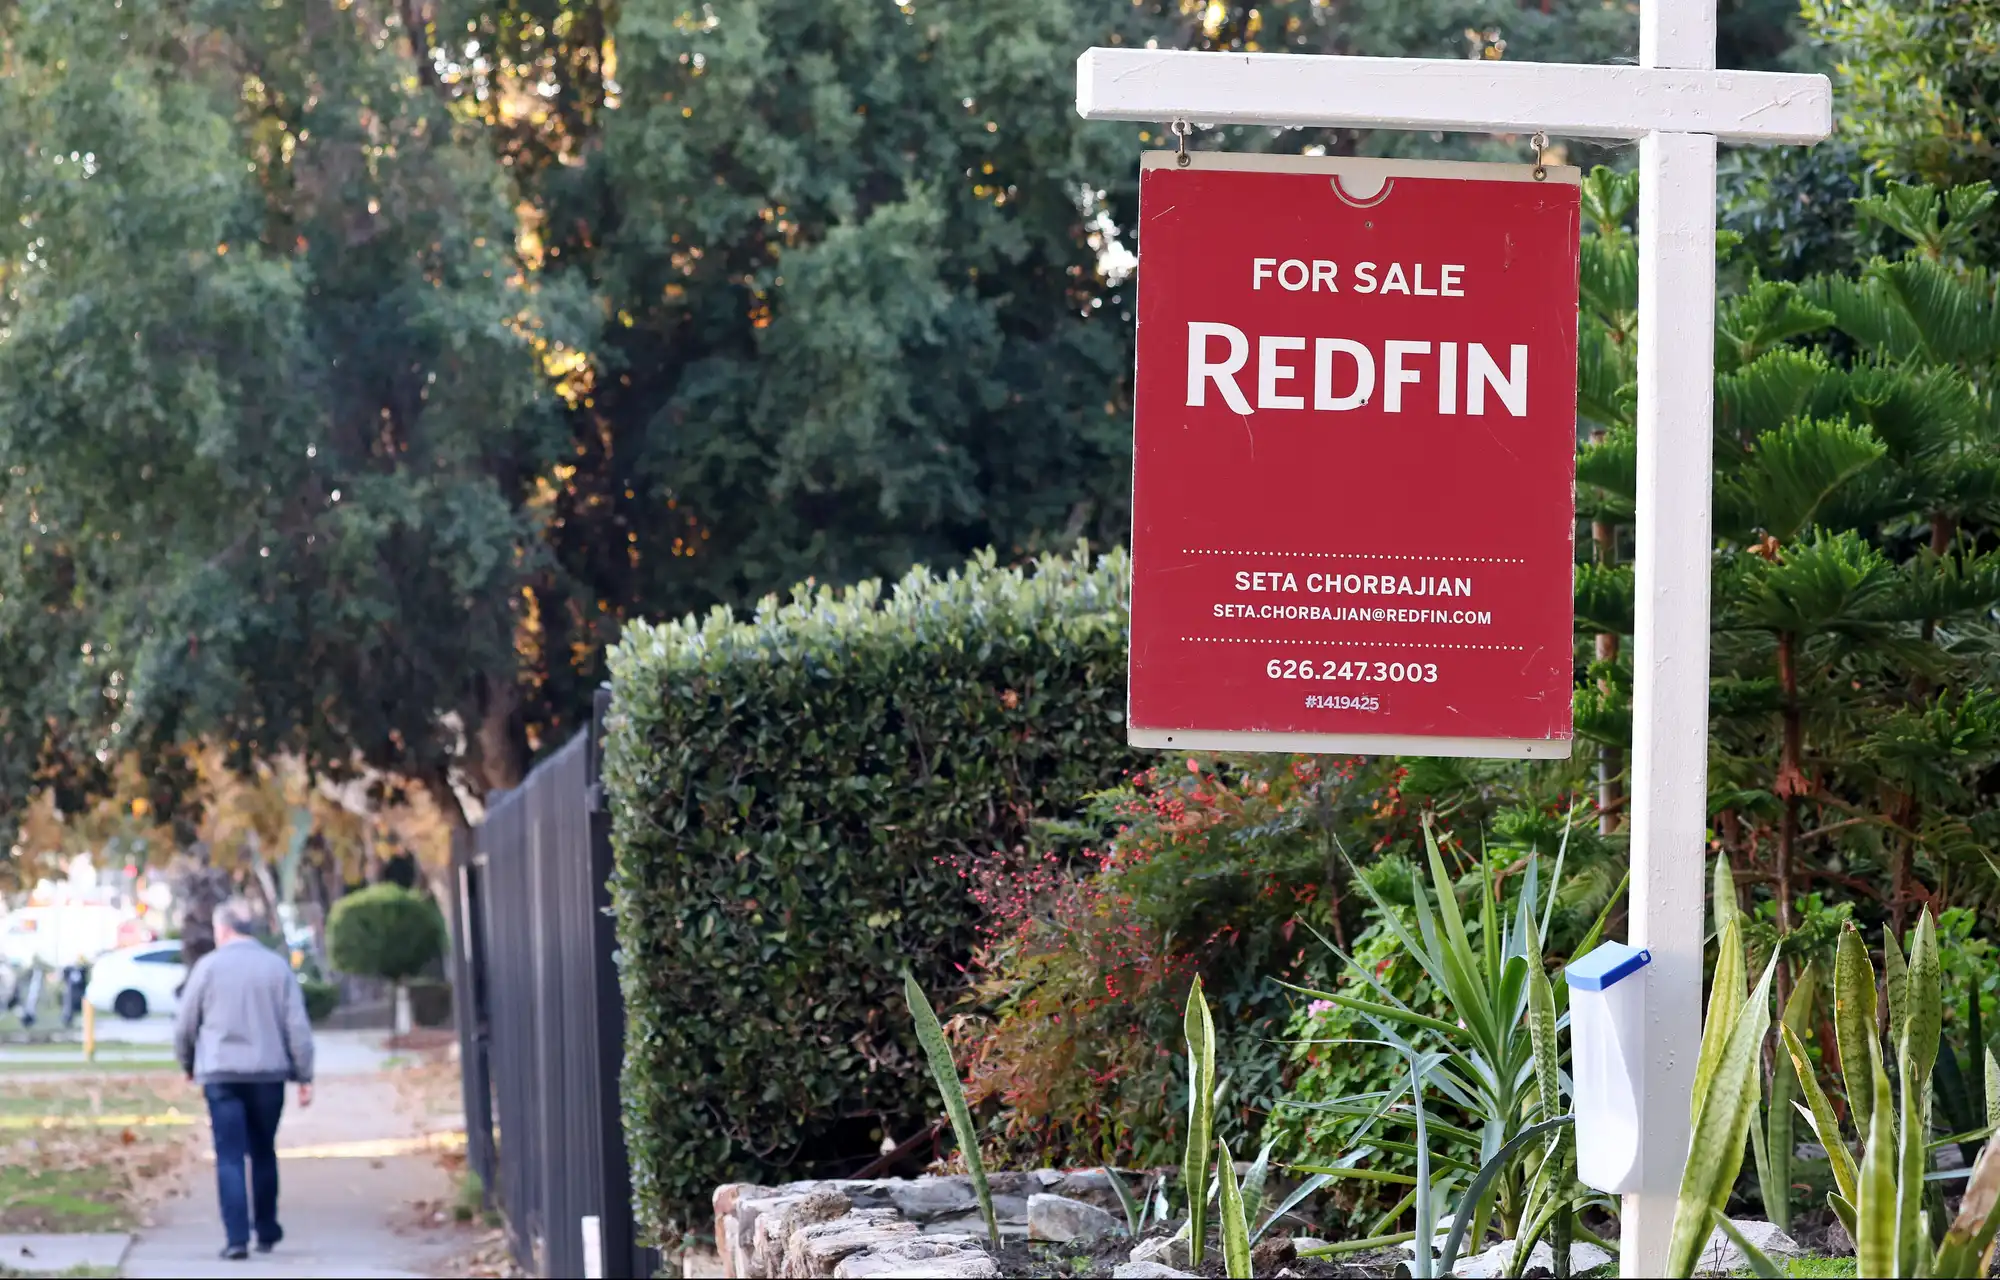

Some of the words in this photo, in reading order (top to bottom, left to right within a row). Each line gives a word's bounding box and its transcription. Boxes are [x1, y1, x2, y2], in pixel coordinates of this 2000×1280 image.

[1252, 257, 1340, 294] FOR
[1353, 261, 1467, 298] SALE
[1185, 321, 1529, 418] REDFIN
[1234, 571, 1299, 593] SETA
[1306, 573, 1472, 598] CHORBAJIAN
[1213, 603, 1492, 626] SETA.CHORBAJIAN@REDFIN.COM
[1266, 658, 1439, 684] 626.247.3003
[1304, 693, 1380, 712] #1419425
